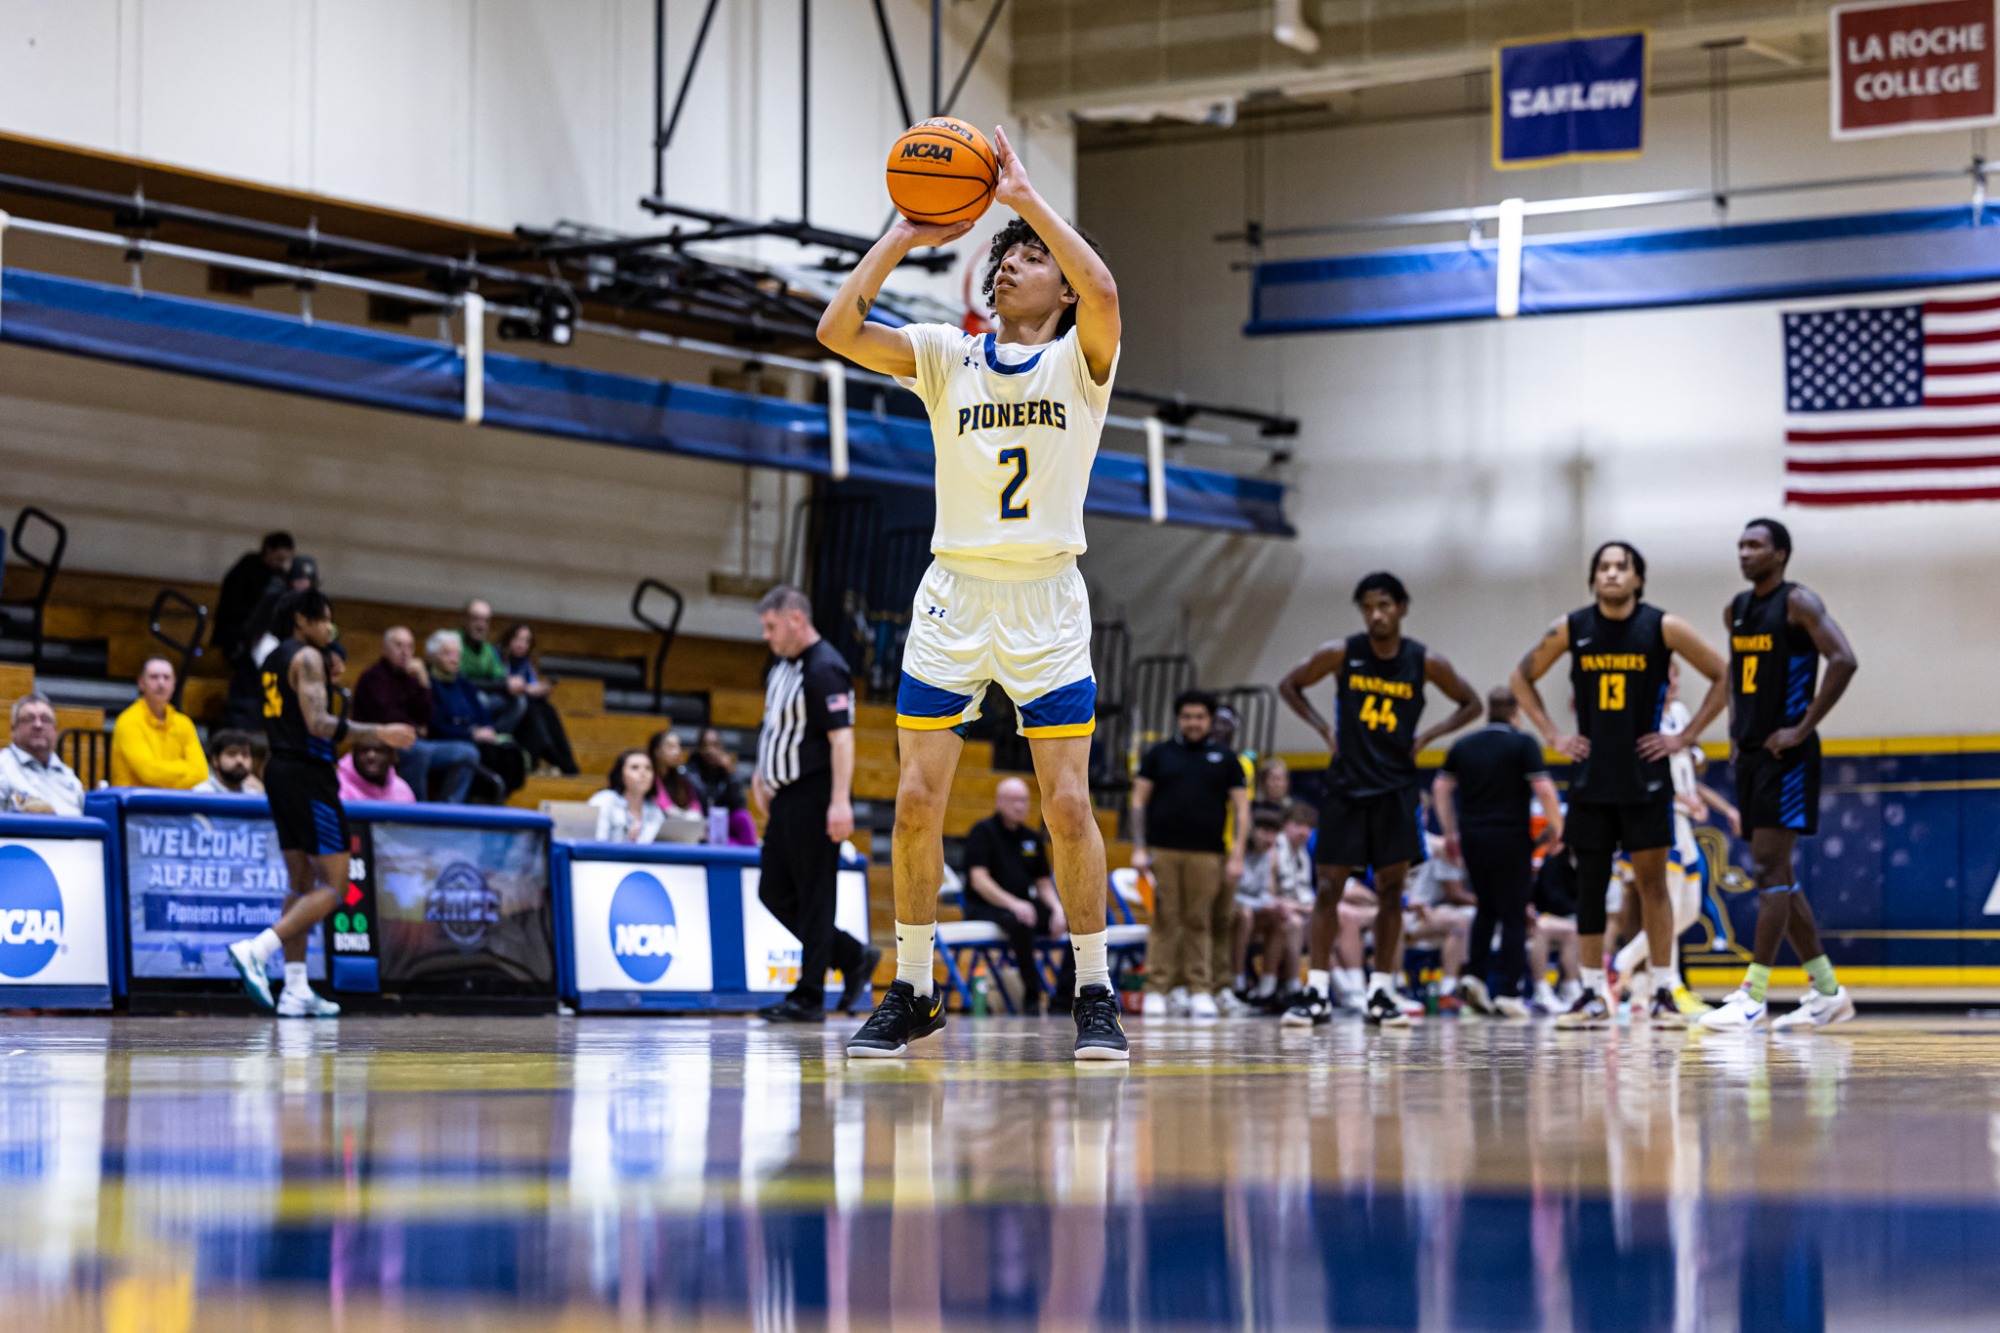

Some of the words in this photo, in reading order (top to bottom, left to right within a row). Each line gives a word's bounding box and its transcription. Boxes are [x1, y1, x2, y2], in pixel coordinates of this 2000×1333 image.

[1848, 33, 1884, 64] LA
[1889, 23, 1985, 59] ROCHE
[1854, 62, 1979, 101] COLLEGE
[901, 143, 953, 162] NCAA
[958, 398, 1067, 437] PIONEERS
[998, 446, 1030, 521] 2
[1580, 653, 1647, 672] PANTHERS
[1599, 673, 1626, 711] 13
[1359, 694, 1398, 733] 44
[138, 827, 267, 860] WELCOME
[150, 863, 231, 890] ALFRED
[166, 900, 220, 924] Pioneers
[221, 906, 236, 925] vs
[615, 923, 682, 958] NCAA
